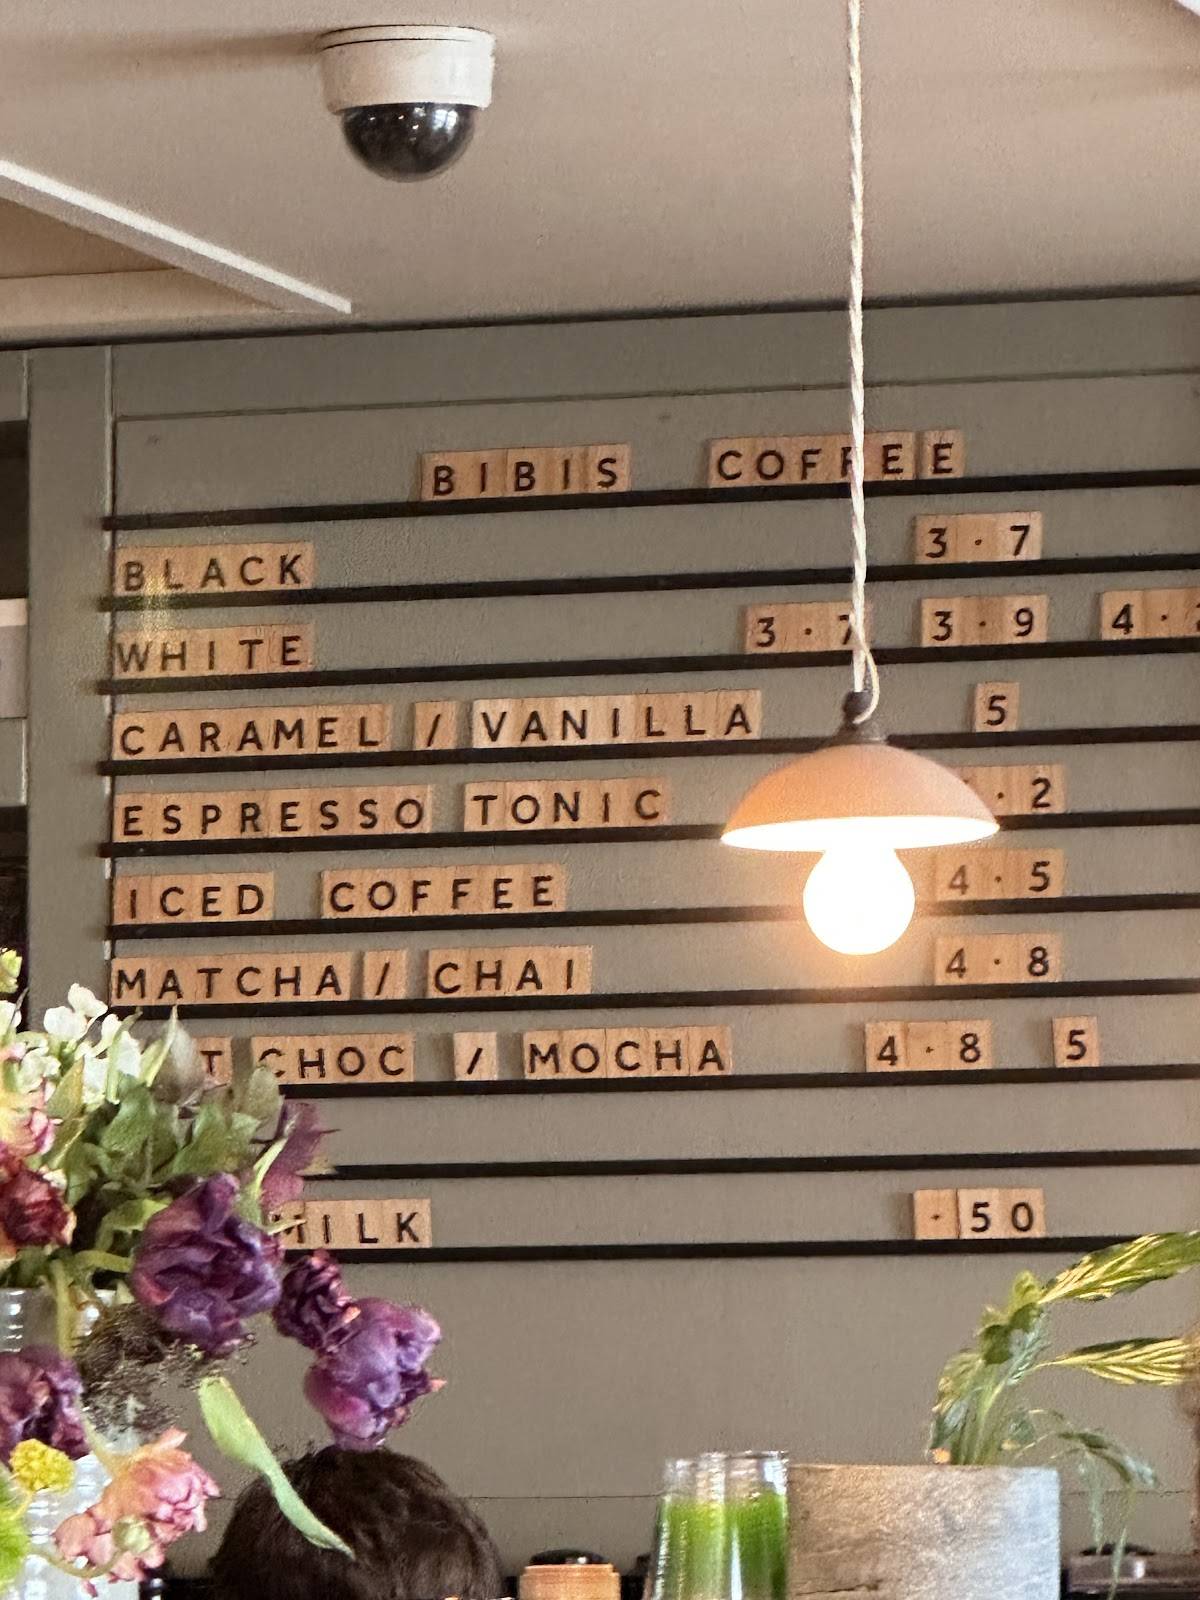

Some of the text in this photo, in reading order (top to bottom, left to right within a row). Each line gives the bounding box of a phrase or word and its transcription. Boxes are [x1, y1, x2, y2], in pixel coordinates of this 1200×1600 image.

[432, 442, 955, 496] BIBIS COFFEE
[124, 553, 302, 592] BLACK
[116, 635, 302, 673] WHITE
[120, 695, 1007, 756] CARAMEL / VANILLA 5
[123, 797, 425, 837] ESPRESSO
[472, 789, 661, 826] TONIC
[128, 884, 264, 919] ICED
[329, 875, 553, 913] COFFEE
[115, 963, 342, 1000] MATCHA
[434, 959, 574, 993] CHAI
[258, 1045, 405, 1079] CHOC
[466, 1047, 483, 1075] /
[529, 1039, 724, 1075] MOCHA
[1066, 1029, 1087, 1061] 5
